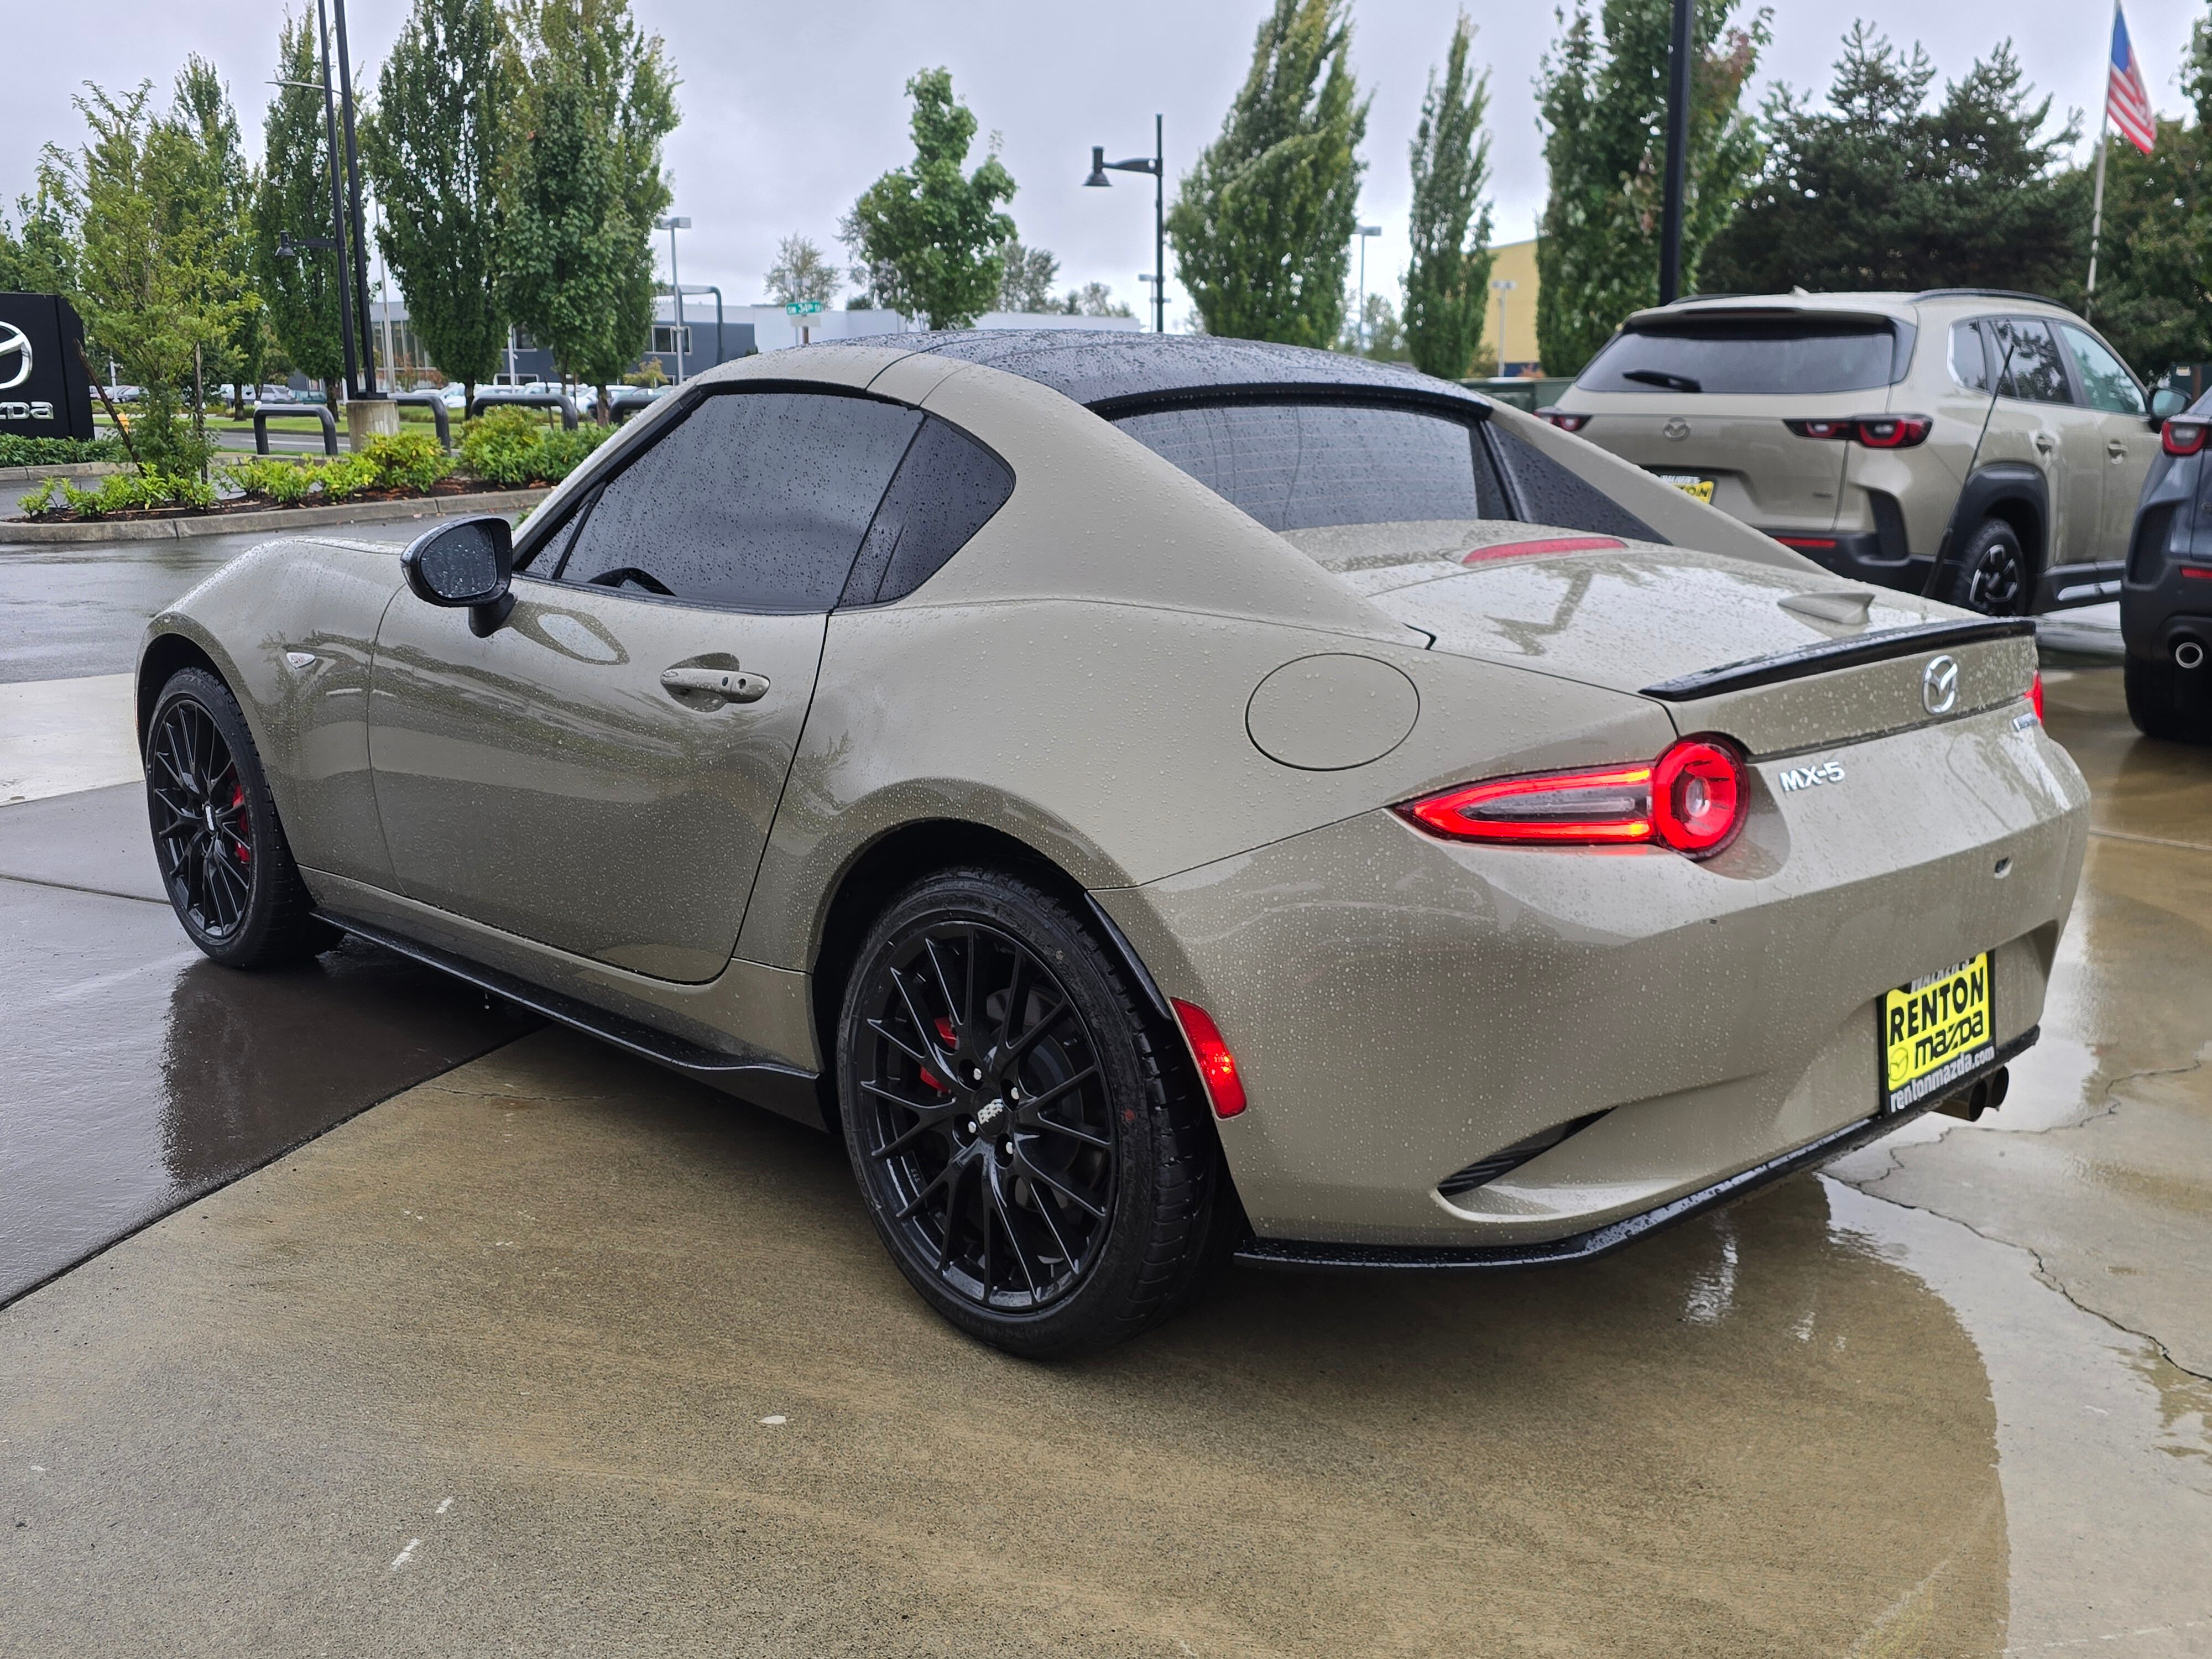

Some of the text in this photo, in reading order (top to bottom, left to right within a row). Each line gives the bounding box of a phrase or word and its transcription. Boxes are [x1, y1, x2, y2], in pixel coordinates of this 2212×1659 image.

[1780, 761, 1845, 792] MX-5
[1890, 966, 1984, 1046] RENTON
[1914, 1010, 1984, 1069] mazda
[1890, 1046, 1995, 1113] rentonmazda.com
